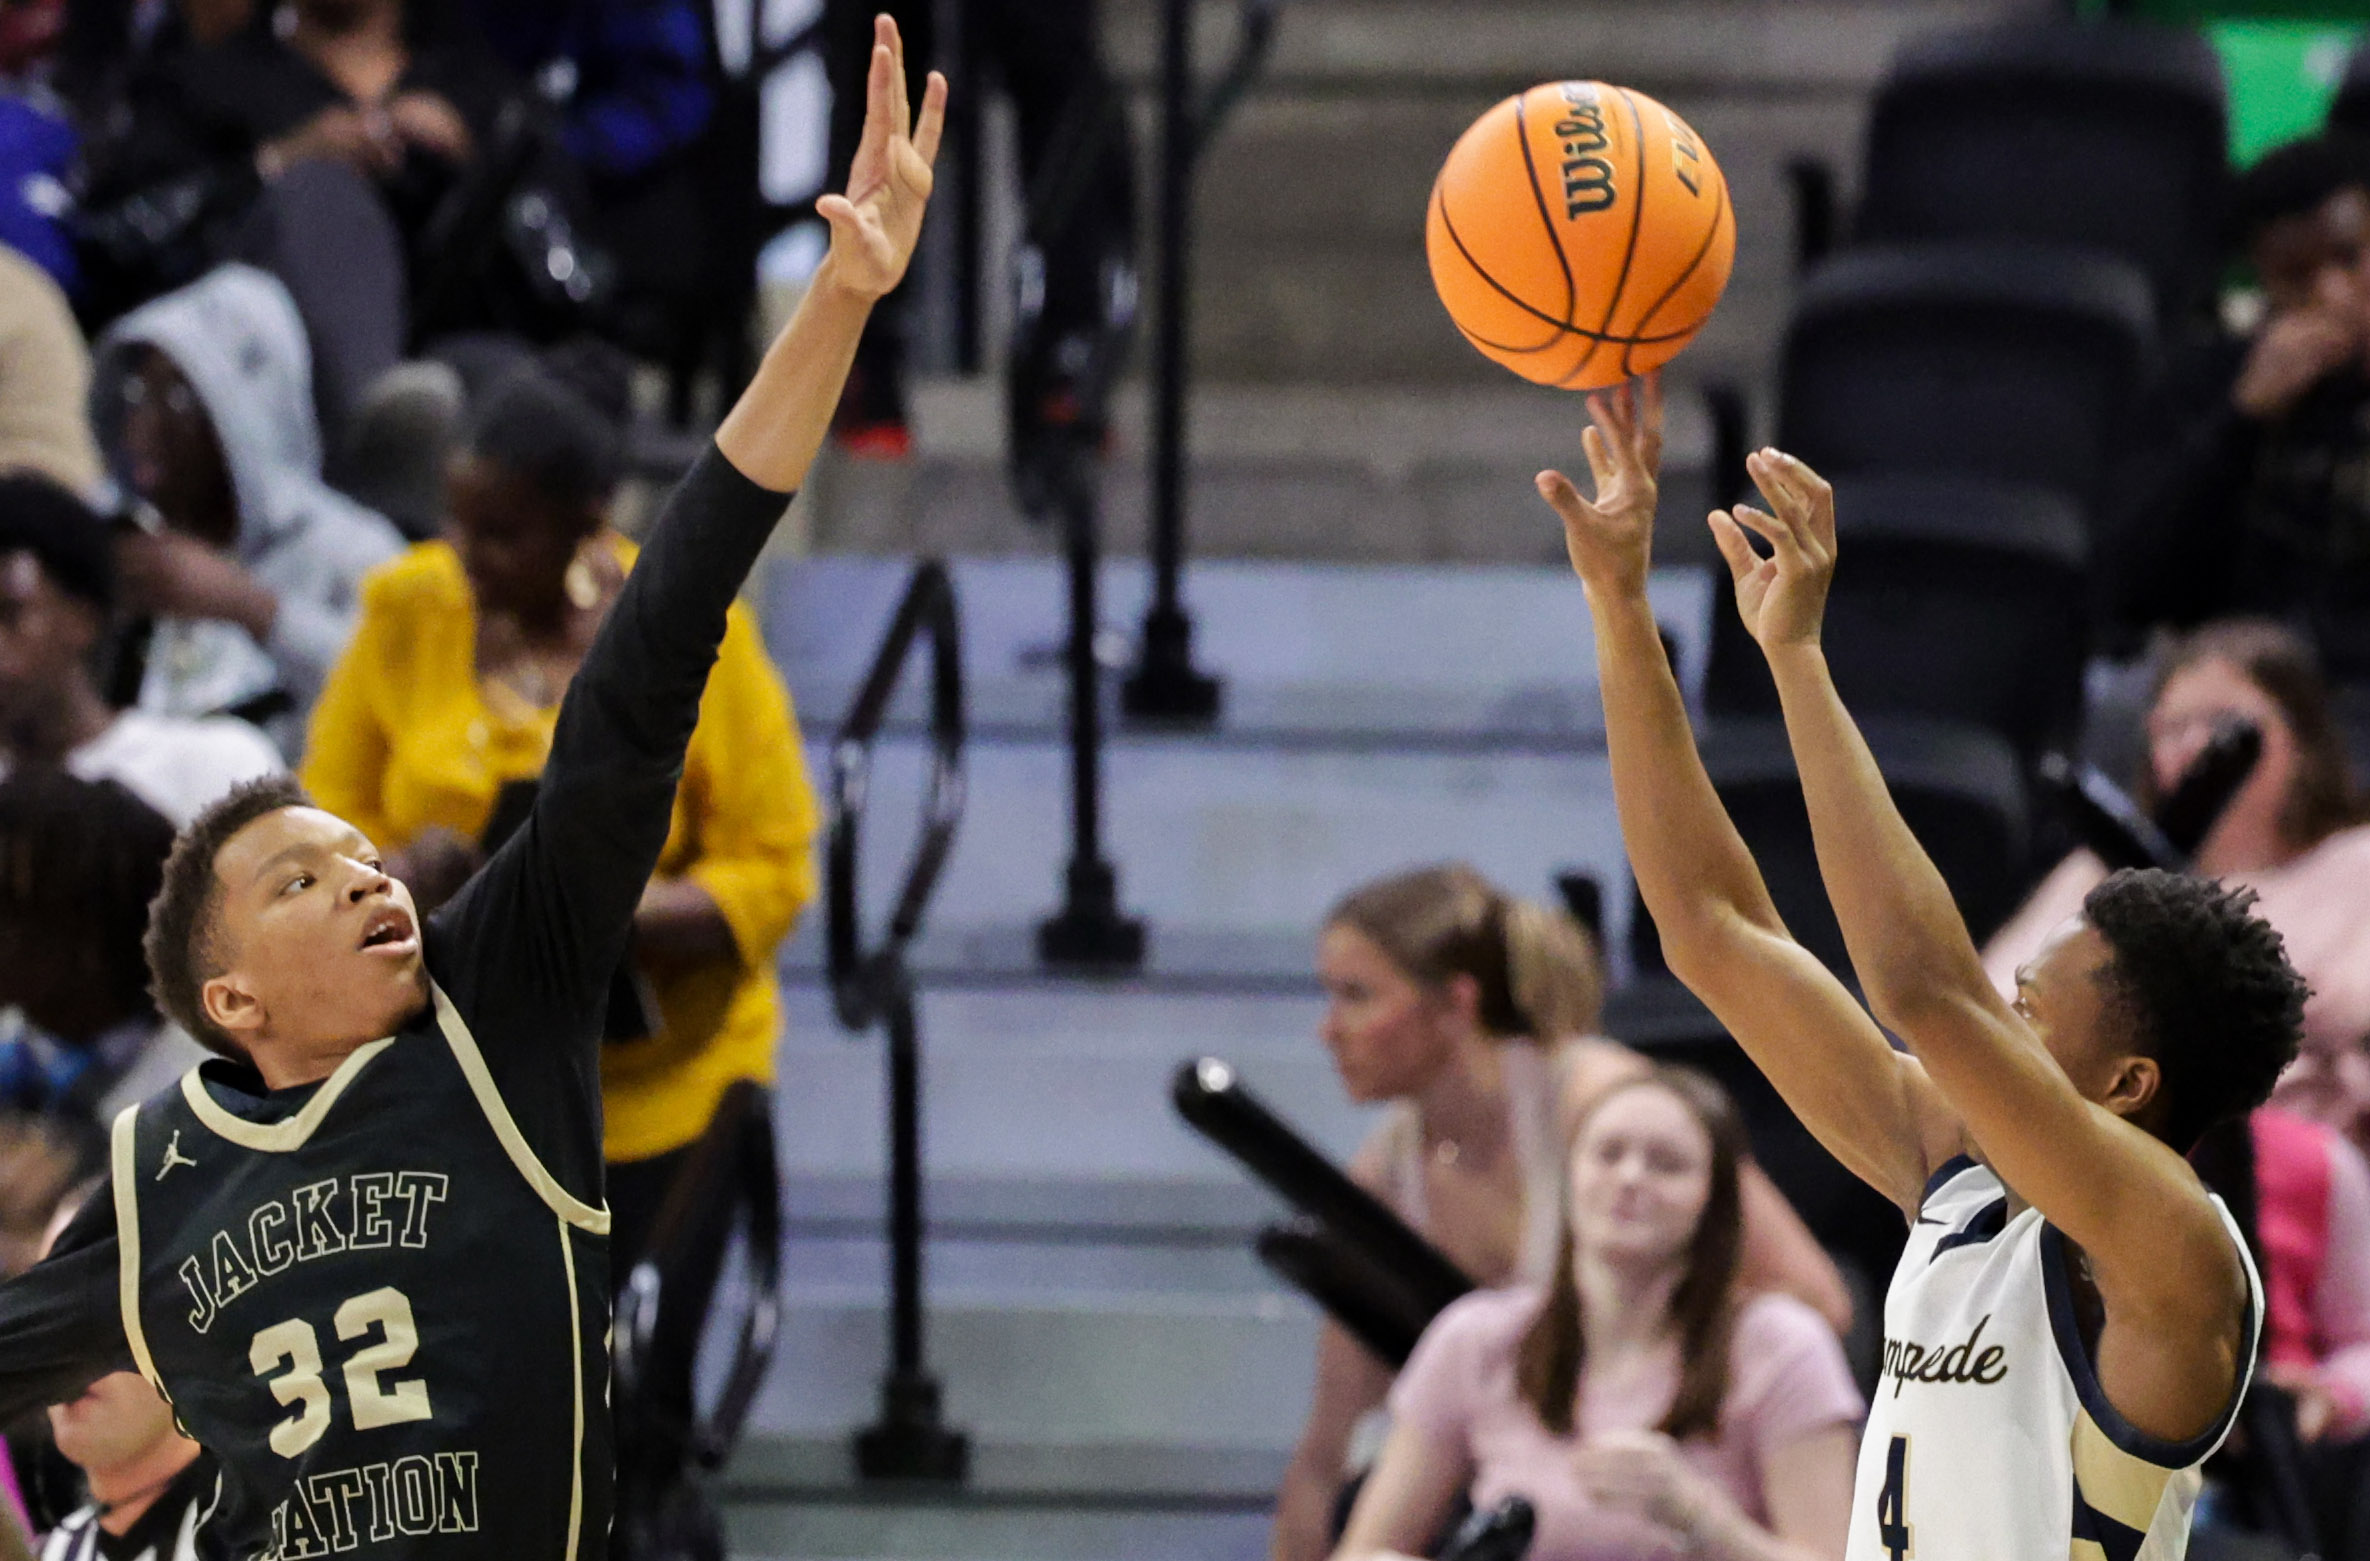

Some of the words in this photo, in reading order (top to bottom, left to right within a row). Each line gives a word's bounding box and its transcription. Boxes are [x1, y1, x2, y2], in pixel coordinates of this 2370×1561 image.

[1554, 81, 1617, 222] Wils
[179, 1171, 448, 1333] JACKET
[248, 1286, 433, 1459] 32
[1883, 1313, 2008, 1399] mpede
[1877, 1432, 1915, 1561] 4
